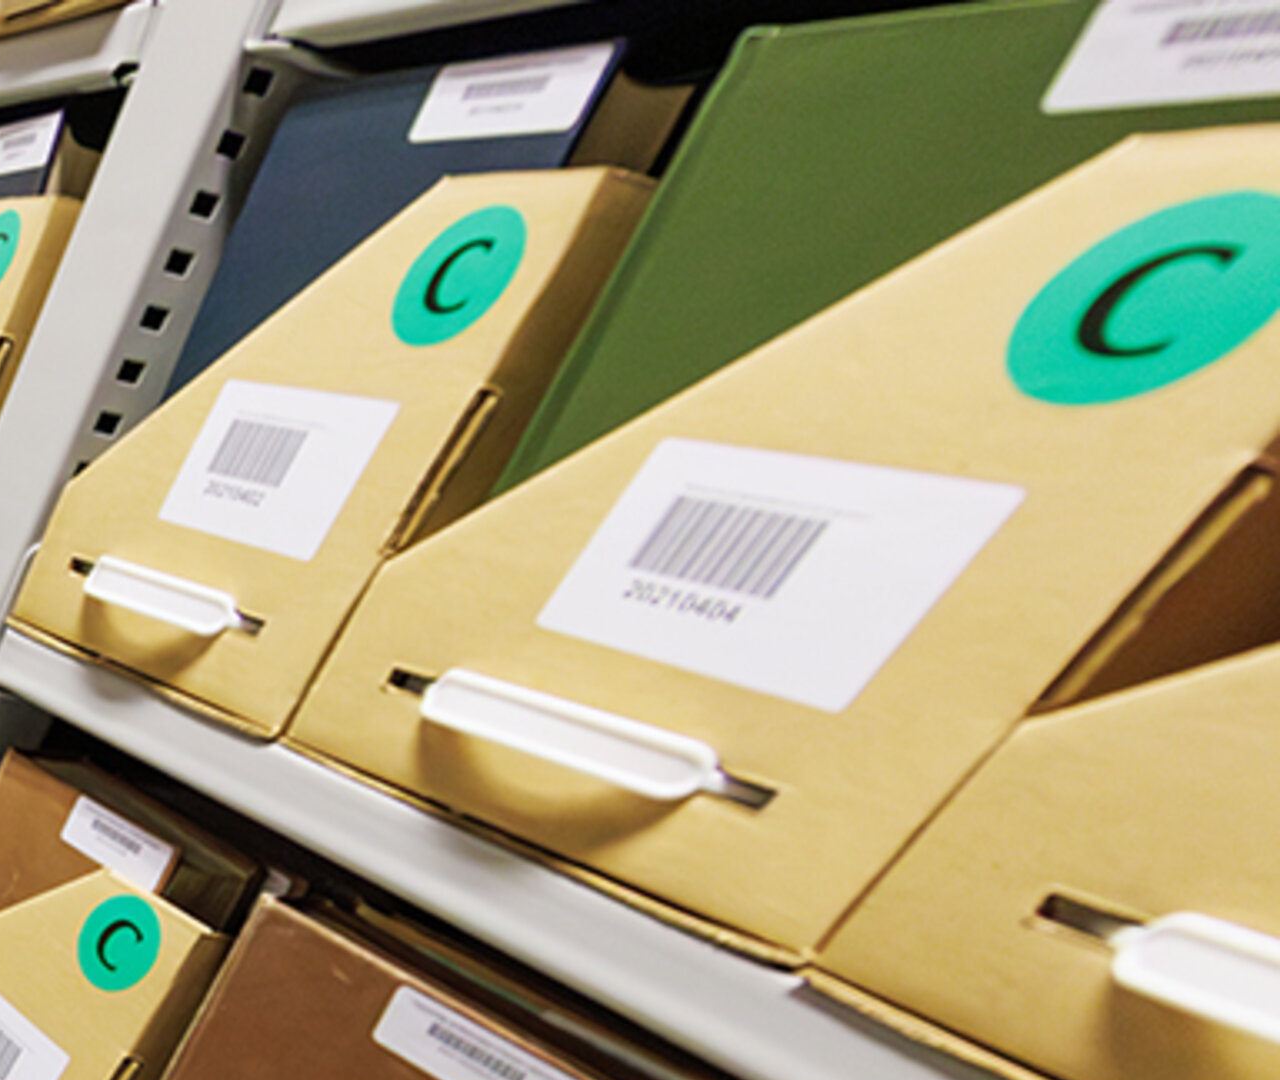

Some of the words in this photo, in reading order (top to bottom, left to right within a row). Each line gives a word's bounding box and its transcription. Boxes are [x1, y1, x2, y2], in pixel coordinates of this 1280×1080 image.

[424, 239, 495, 315] C
[1075, 244, 1240, 359] C
[622, 579, 743, 624] 20210404
[96, 919, 144, 972] C
